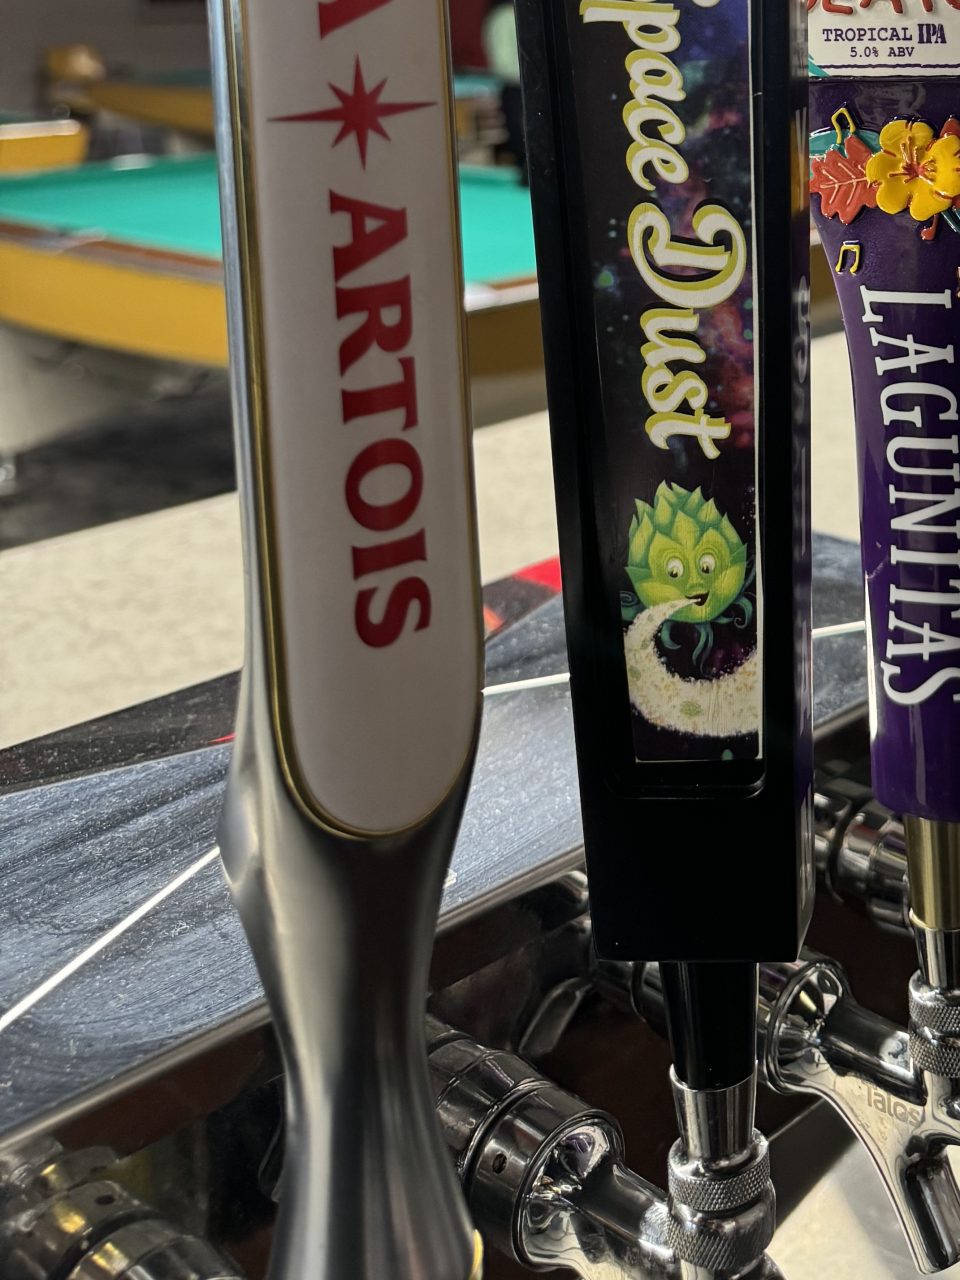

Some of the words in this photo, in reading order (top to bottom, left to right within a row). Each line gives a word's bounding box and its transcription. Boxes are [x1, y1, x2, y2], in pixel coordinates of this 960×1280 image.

[823, 27, 912, 42] TROPICAL
[918, 23, 946, 44] IPA
[850, 46, 879, 58] 5.0%
[888, 46, 915, 58] ABV
[629, 202, 747, 460] Dust
[329, 190, 431, 649] ARTOIS
